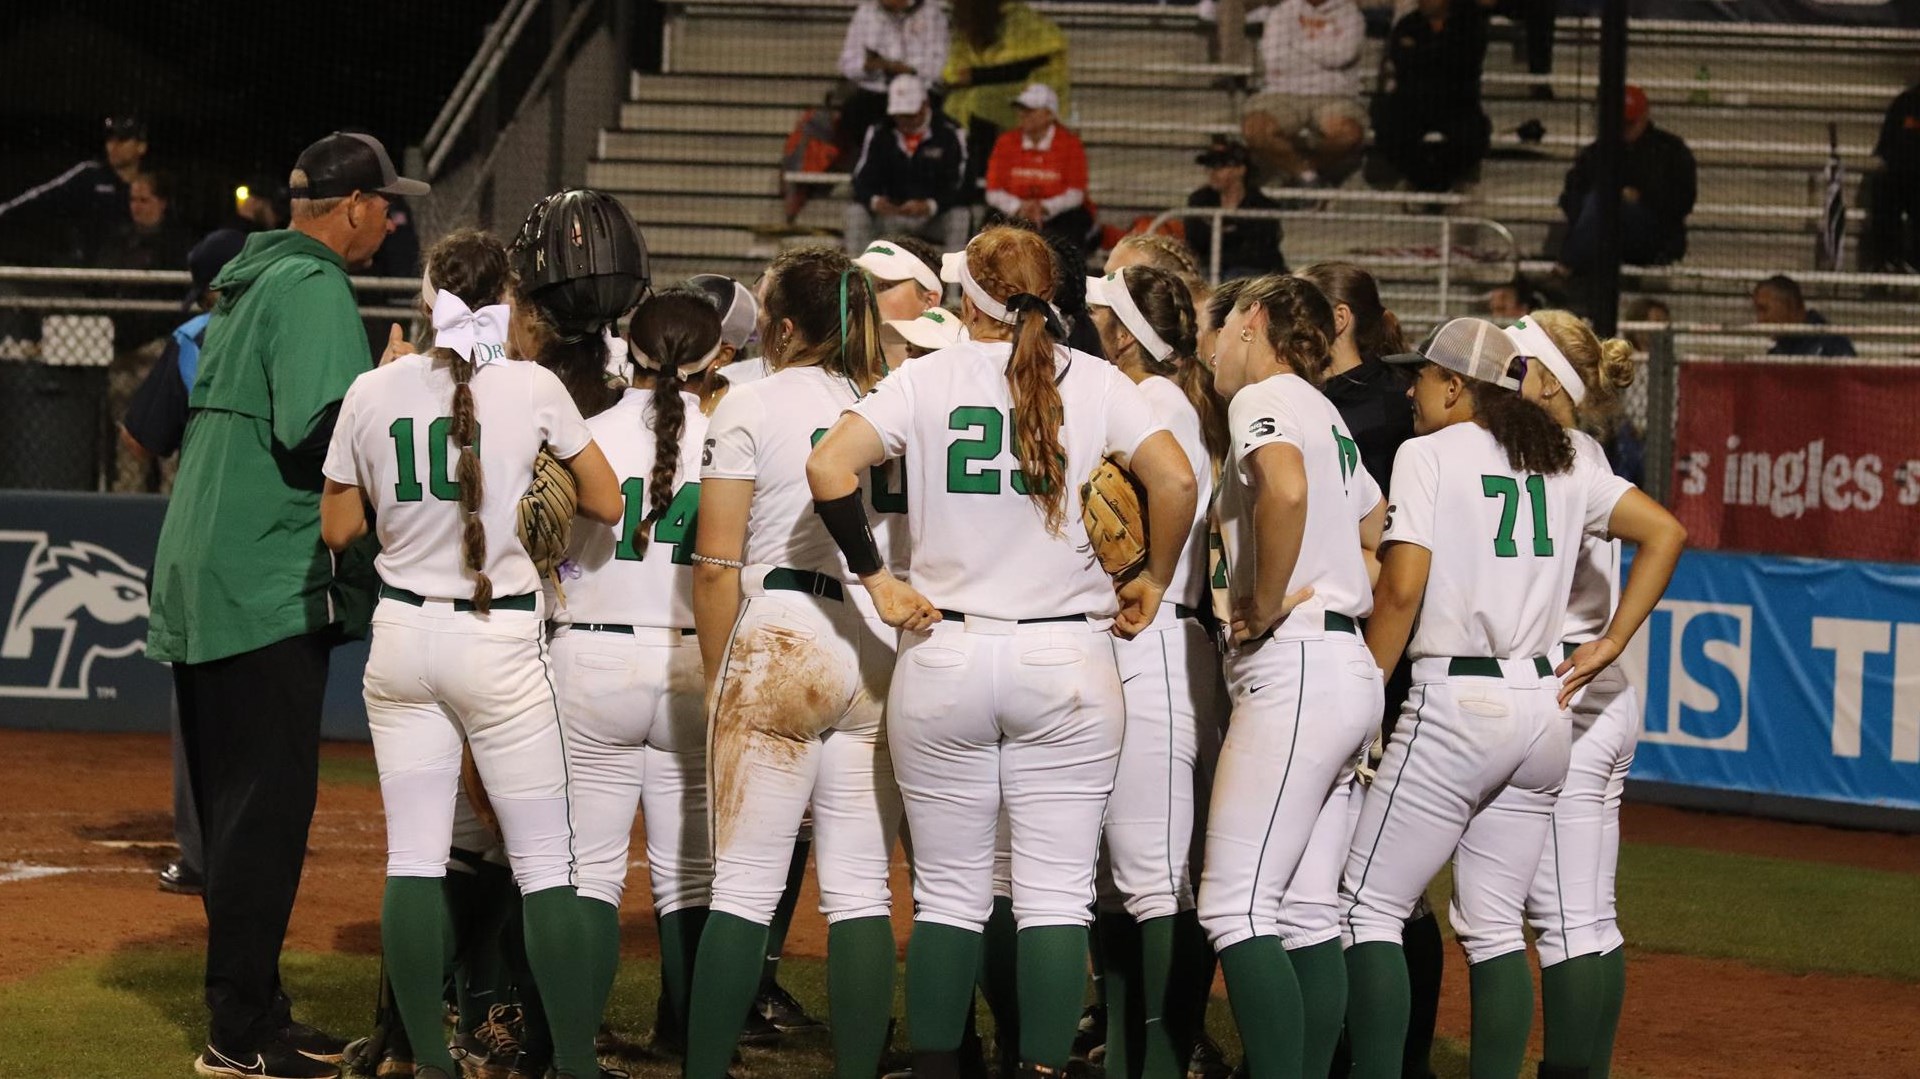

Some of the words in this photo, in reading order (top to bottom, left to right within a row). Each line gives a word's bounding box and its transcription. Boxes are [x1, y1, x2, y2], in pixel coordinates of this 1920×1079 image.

[389, 416, 481, 502] 10
[1723, 435, 1883, 519] ingles
[615, 476, 702, 565] 14
[1481, 474, 1553, 557] 71
